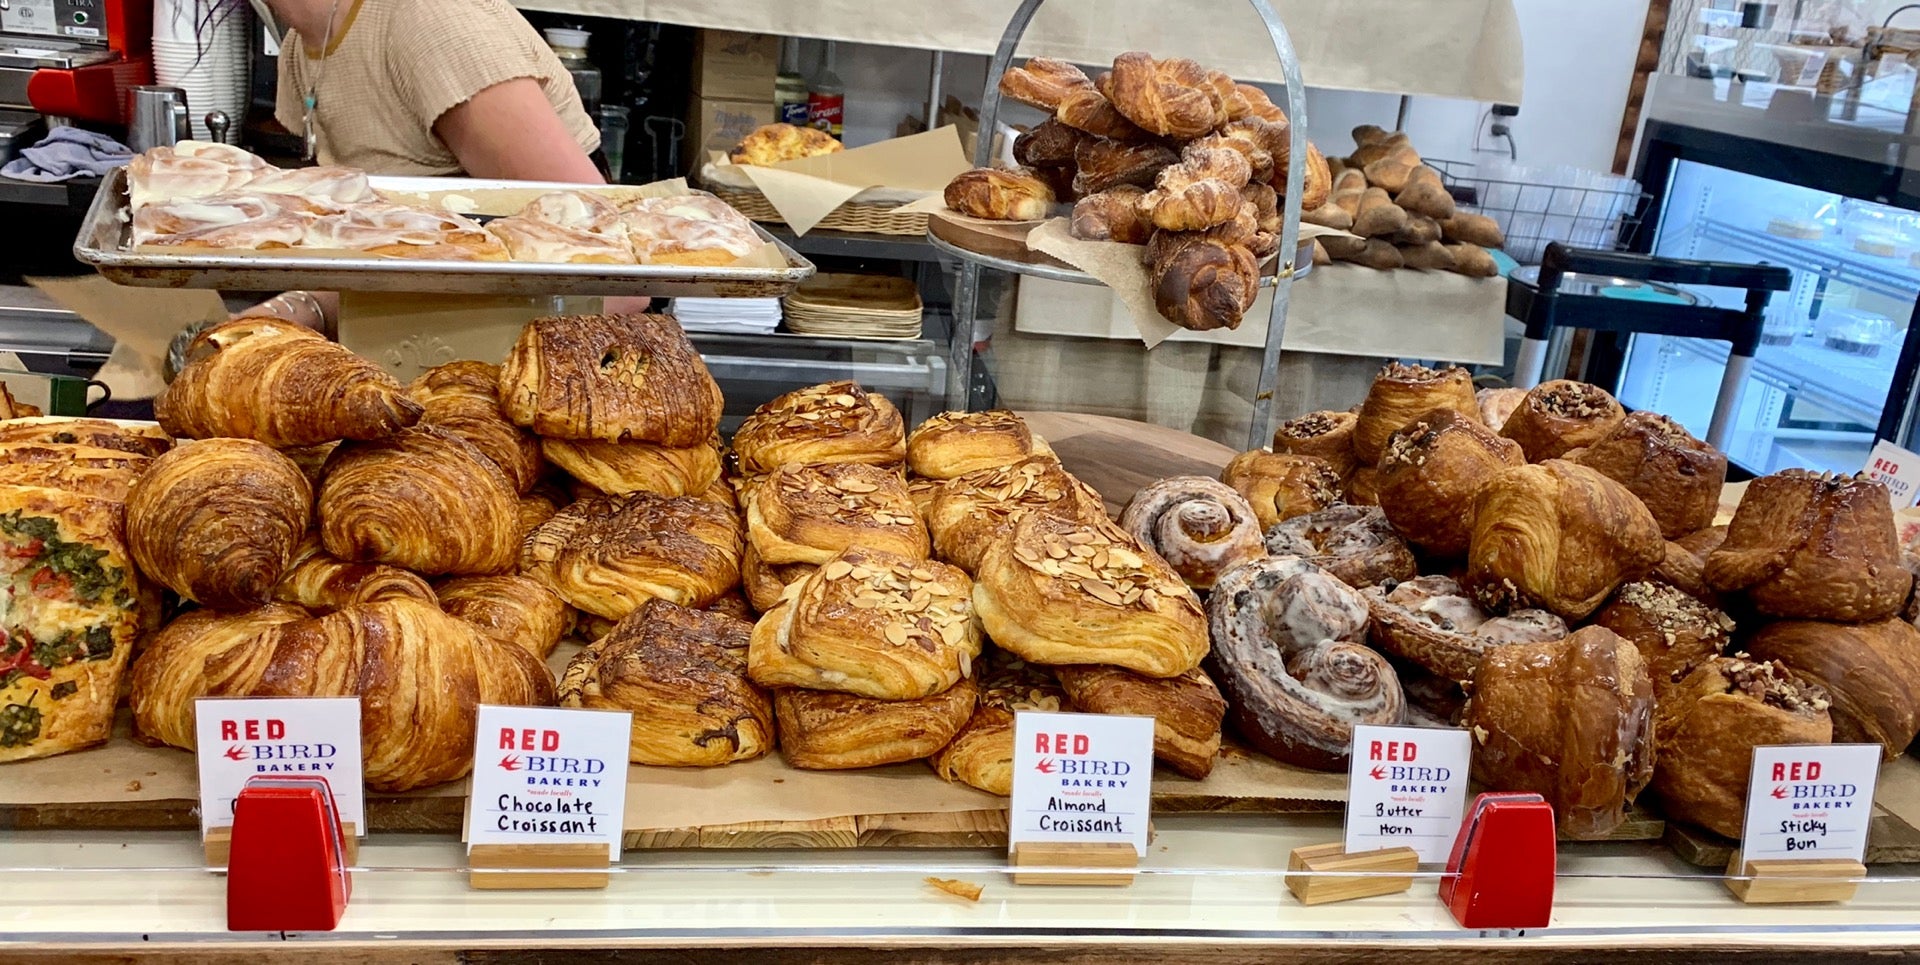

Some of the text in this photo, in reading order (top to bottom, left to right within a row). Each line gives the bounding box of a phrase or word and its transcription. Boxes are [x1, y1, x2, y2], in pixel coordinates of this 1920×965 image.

[1873, 458, 1899, 475] RED
[221, 719, 286, 741] RED
[499, 728, 560, 752] RED
[1035, 733, 1089, 755] RED
[251, 743, 337, 760] BIRD
[1370, 740, 1417, 762] RED
[257, 762, 335, 773] BAKERY
[525, 756, 605, 774] BIRD
[1059, 759, 1131, 776] BIRD
[1771, 761, 1822, 782] RED
[527, 776, 602, 787] BAKERY
[1390, 766, 1451, 782] BIRD
[1062, 778, 1128, 789] BAKERY
[1391, 784, 1448, 793] BAKERY
[1792, 784, 1857, 799] BIRD
[498, 794, 593, 815] Chocolate
[1047, 796, 1106, 813] Almond
[1375, 802, 1423, 817] Butter
[1793, 801, 1853, 810] BAKERY
[497, 815, 597, 833] Croissant
[1040, 814, 1122, 832] Croissant
[1380, 823, 1413, 836] Horn
[1779, 819, 1827, 836] Sticky
[1786, 837, 1817, 851] Bun
